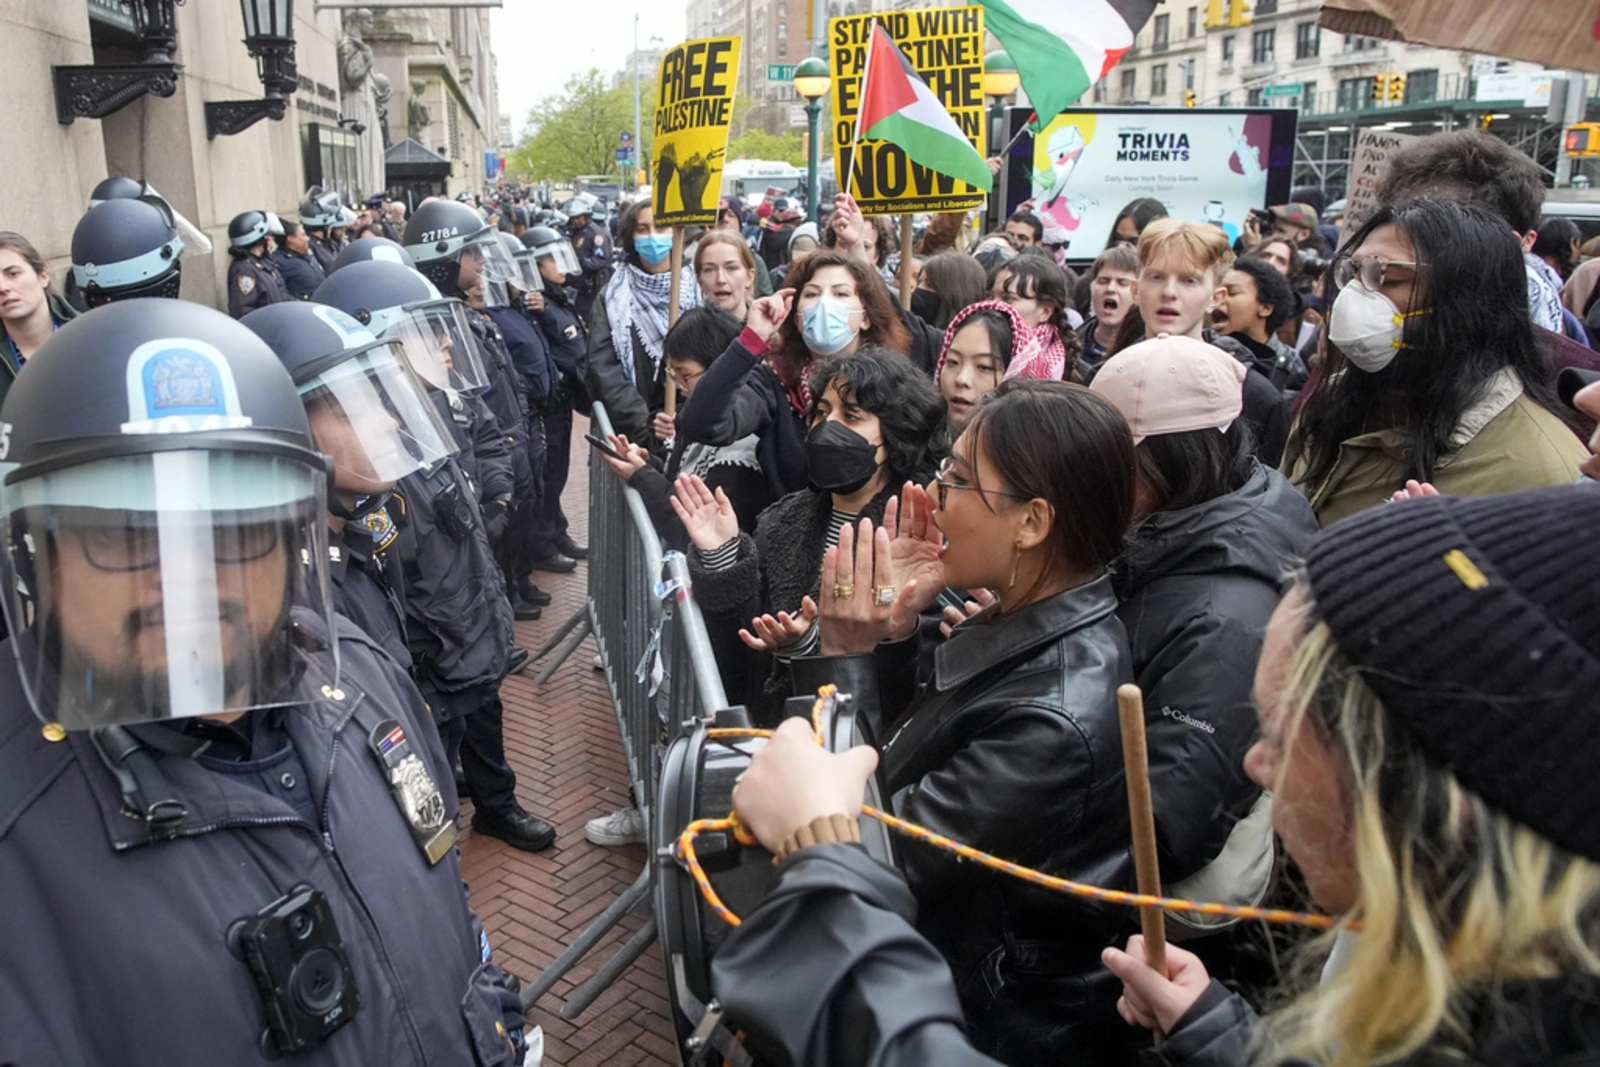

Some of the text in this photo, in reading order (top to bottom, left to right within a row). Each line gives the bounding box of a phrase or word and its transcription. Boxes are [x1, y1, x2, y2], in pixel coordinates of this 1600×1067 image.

[916, 8, 979, 37] WITH
[835, 36, 980, 76] PASTINE!
[660, 41, 732, 108] FREE
[770, 66, 779, 79] W
[655, 98, 732, 137] PALESTINE
[1118, 133, 1190, 149] TRIVIA
[1116, 150, 1190, 162] MOMENTS
[1105, 175, 1122, 183] Daily
[1128, 185, 1155, 193] Coming
[859, 199, 984, 213] arty for Socialism and Liberation
[1171, 709, 1215, 734] Columbia
